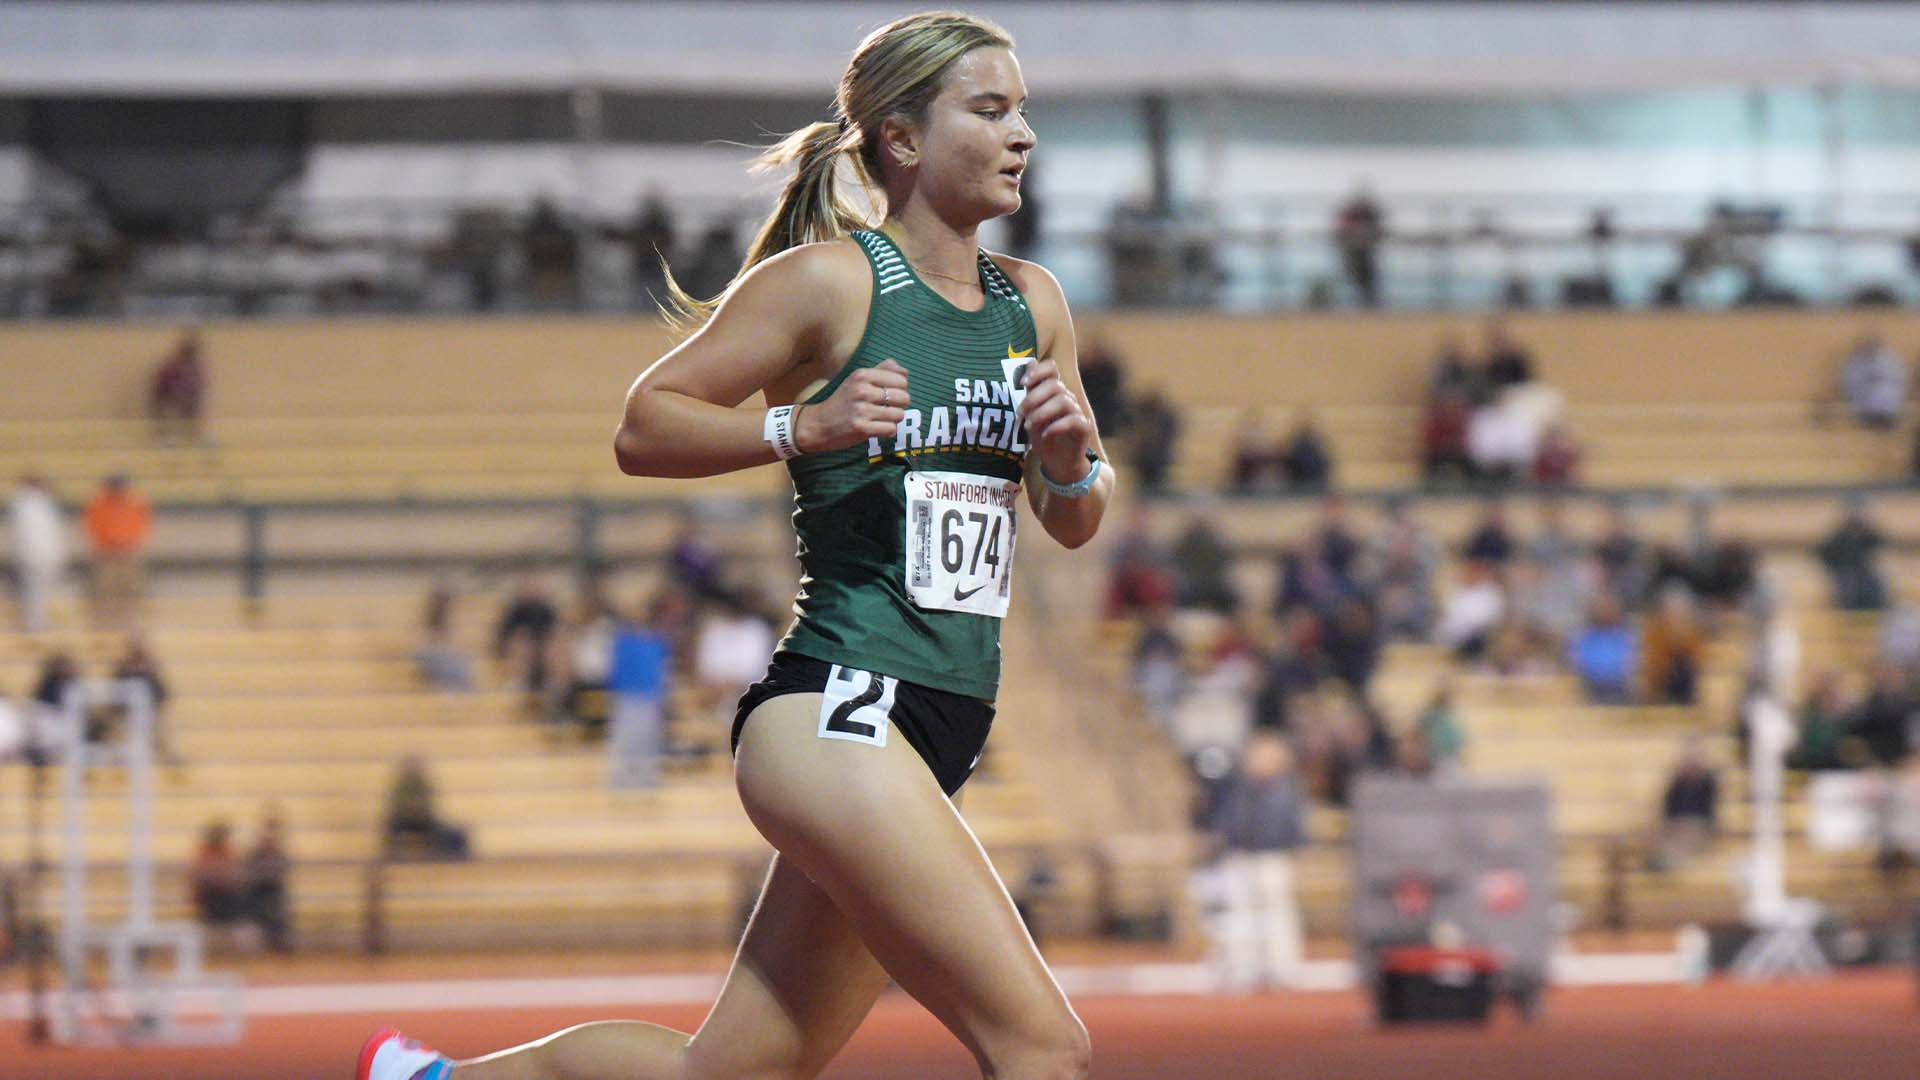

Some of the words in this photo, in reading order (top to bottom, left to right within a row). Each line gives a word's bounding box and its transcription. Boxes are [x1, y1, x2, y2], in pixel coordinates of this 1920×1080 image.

[955, 378, 1010, 405] SAN
[868, 406, 1016, 456] RANCI
[925, 481, 988, 505] STANFORD
[941, 509, 1002, 579] 674
[826, 667, 885, 738] 2
